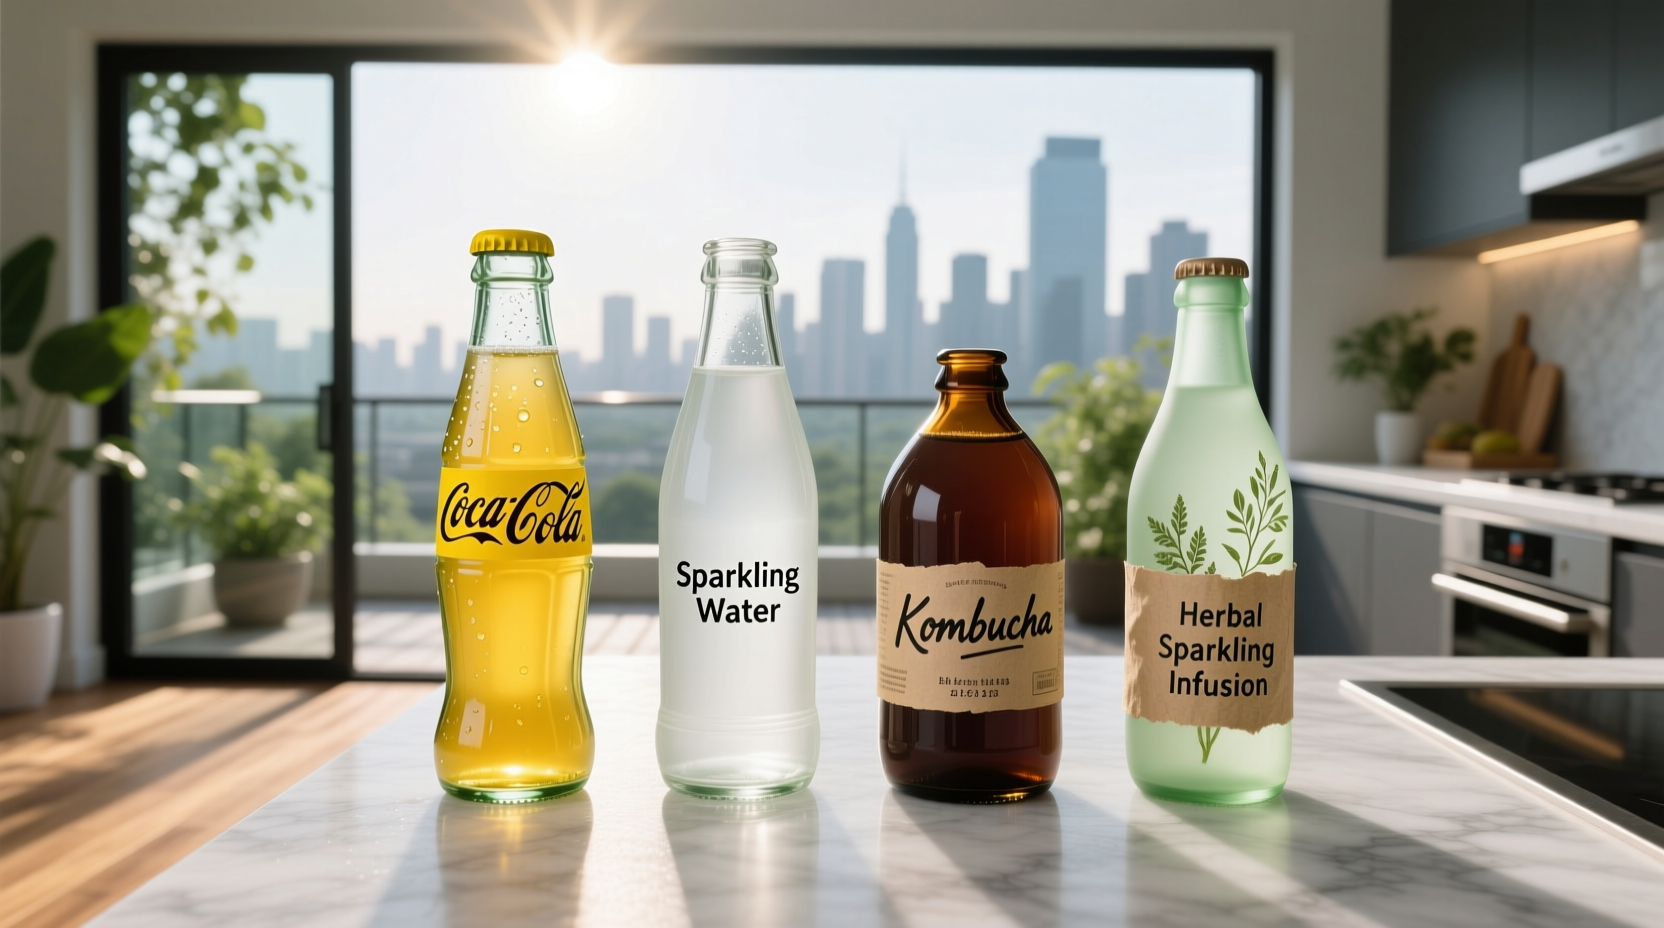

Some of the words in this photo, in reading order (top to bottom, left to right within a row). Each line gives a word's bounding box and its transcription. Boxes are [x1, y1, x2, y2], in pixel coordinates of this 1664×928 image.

[440, 478, 585, 546] Coca-Cola
[676, 561, 800, 594] Sparkling
[697, 598, 780, 624] Water
[894, 593, 1053, 654] Kombucha
[1180, 602, 1262, 628] Herbal
[1159, 634, 1275, 668] Sparkling
[1170, 671, 1268, 698] Infusion
